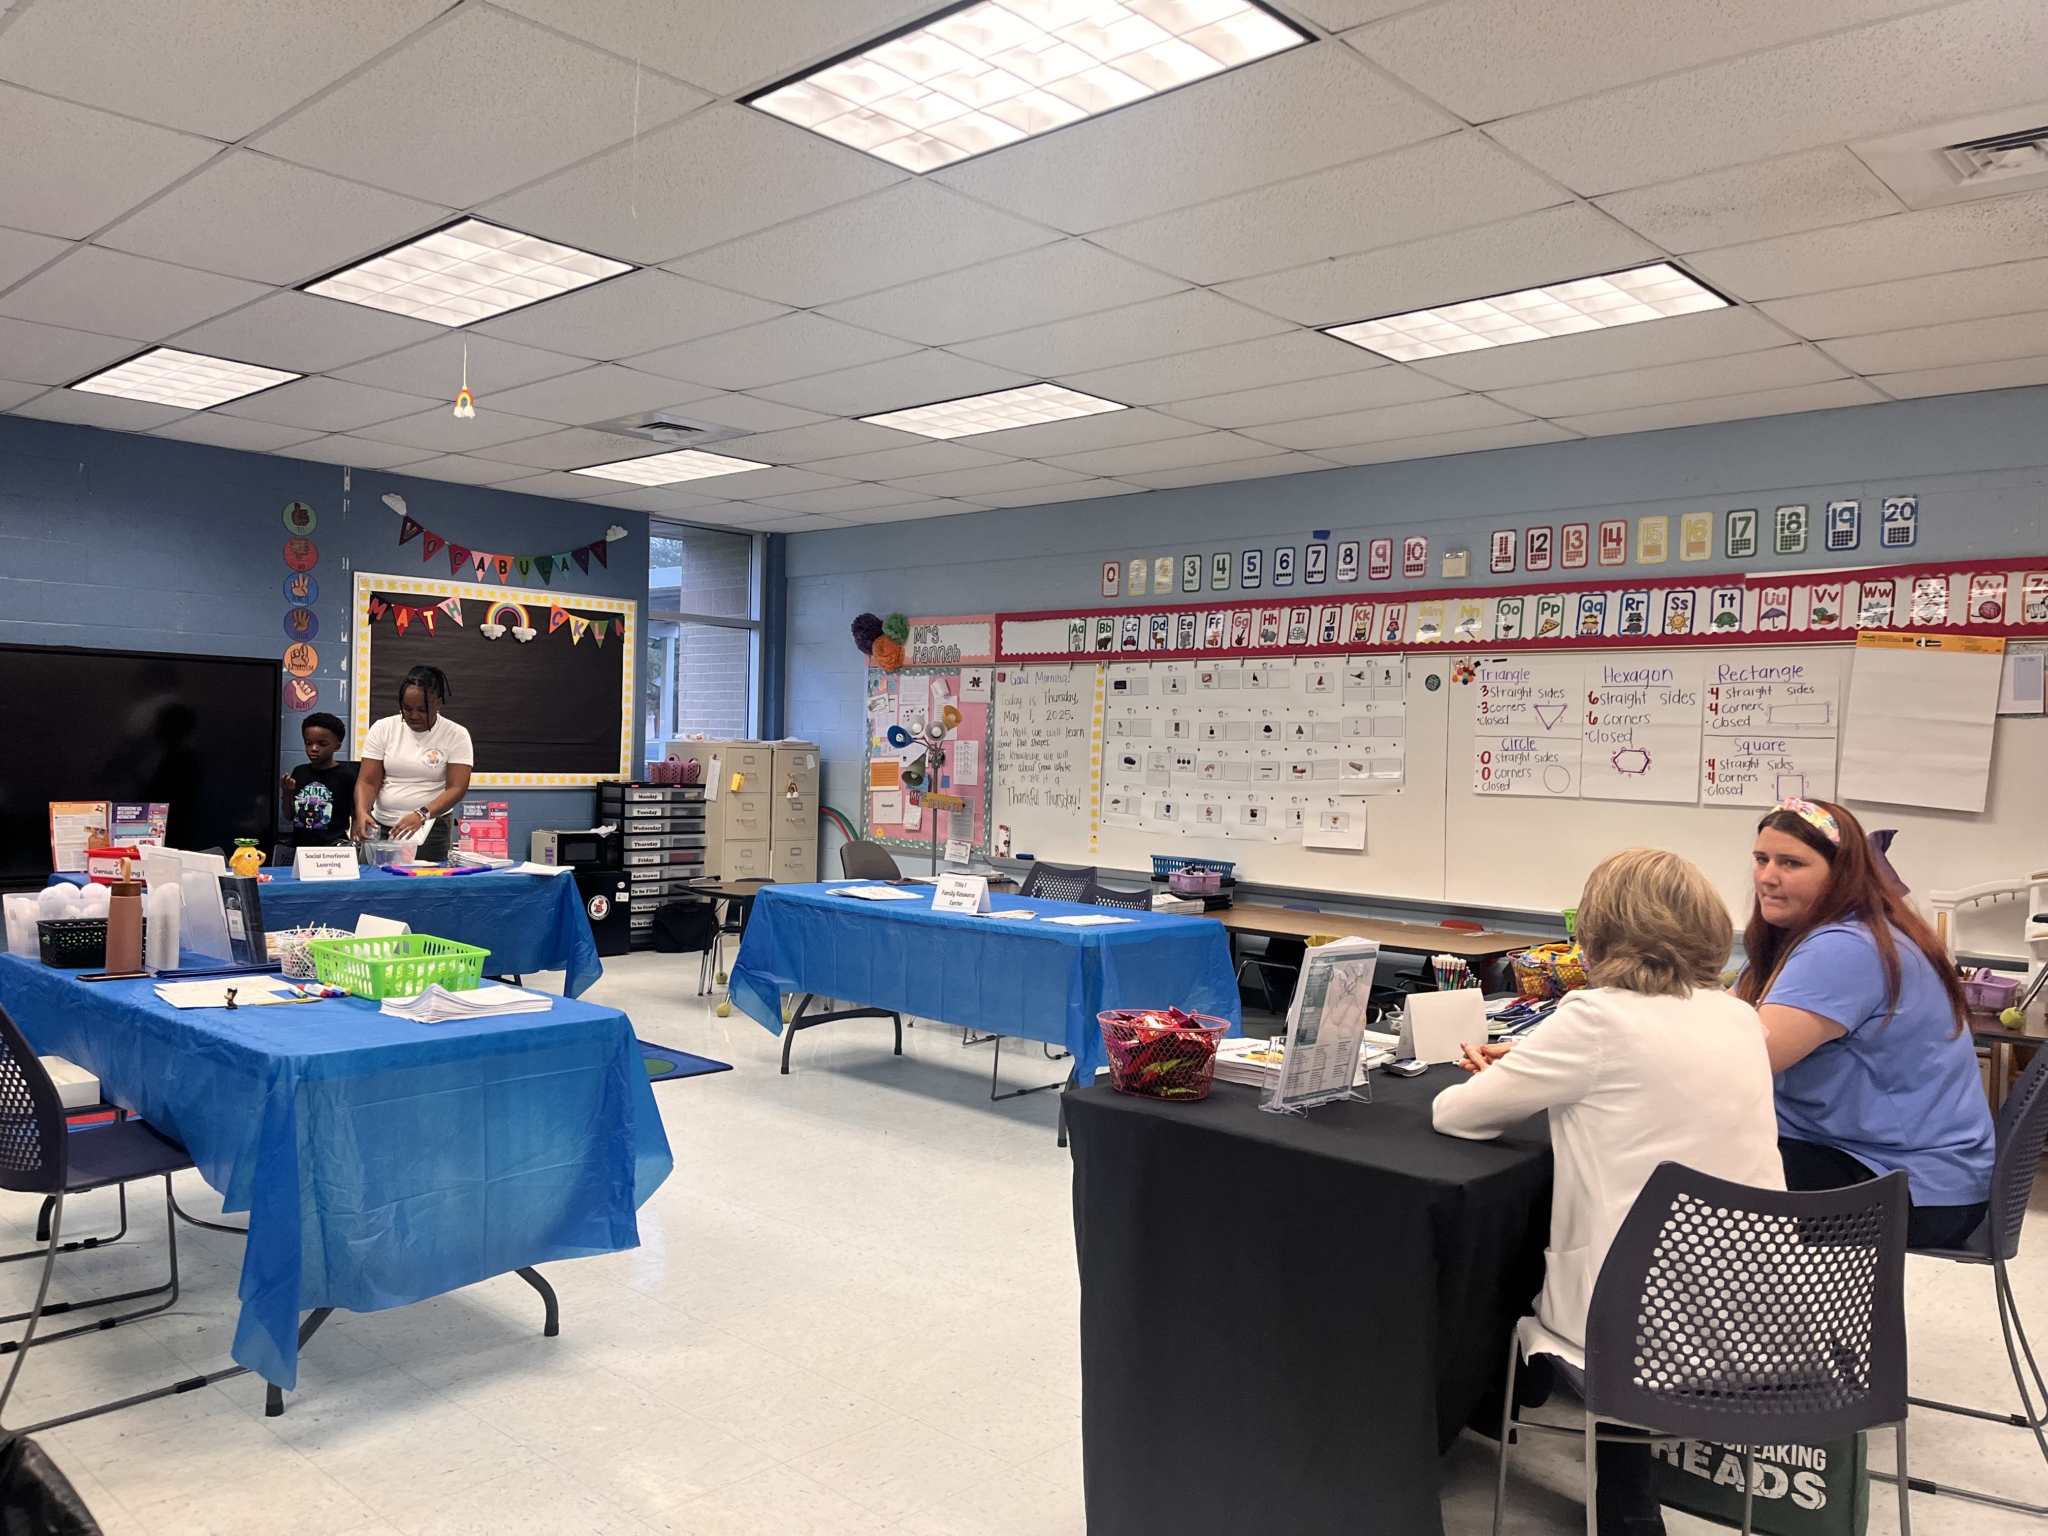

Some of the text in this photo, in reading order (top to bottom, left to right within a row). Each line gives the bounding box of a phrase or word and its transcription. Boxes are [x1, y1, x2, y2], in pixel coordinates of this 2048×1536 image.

[1831, 506, 1856, 530] 19
[1884, 502, 1915, 522] 20
[1686, 519, 1707, 541] 16
[1731, 516, 1752, 539] 17
[1780, 511, 1802, 535] 18
[1565, 529, 1583, 550] 13
[1603, 526, 1622, 548] 14
[1643, 523, 1662, 545] 15
[1499, 536, 1509, 555] 11
[1530, 533, 1548, 553] 12
[1311, 550, 1322, 568] 7
[1342, 548, 1354, 565] 8
[1375, 544, 1387, 562] 9
[1406, 542, 1424, 561] 10
[1216, 558, 1227, 575] 4
[1247, 556, 1257, 573] 5
[1279, 553, 1290, 569] 6
[1106, 566, 1116, 583] 0
[1187, 561, 1197, 577] 3
[1814, 589, 1839, 603] Vv
[1863, 585, 1892, 598] Ww
[1976, 580, 2001, 599] Yy
[1625, 598, 1644, 612] Rr
[1671, 597, 1689, 611] Ss
[1719, 593, 1736, 608] Tt
[1765, 592, 1786, 606] Uu
[367, 598, 462, 630] MATH
[1355, 609, 1370, 621] Kk
[1390, 609, 1400, 621] Ll
[1420, 606, 1442, 617] Mm
[1460, 605, 1480, 617] Nn
[1500, 603, 1520, 615] Oo
[1541, 602, 1560, 617] Pp
[1582, 600, 1603, 615] Qq
[552, 611, 626, 640] CKLA
[1152, 620, 1166, 631] Dd
[1180, 619, 1193, 630] Ee
[1209, 617, 1220, 628] Ff
[1234, 616, 1249, 629] Gg
[1263, 613, 1277, 626] Hh
[1295, 612, 1305, 624] Ii
[1326, 611, 1336, 625] Jj
[913, 626, 943, 644] Mrs.
[1071, 623, 1084, 634] Aa
[1099, 623, 1111, 633] Bb
[1125, 623, 1137, 632] Cc
[913, 644, 961, 664] Hannah
[1010, 670, 1071, 687] Good Morning!
[1480, 668, 1531, 685] Triangle
[1604, 665, 1673, 689] Hexagon
[1718, 664, 1803, 684] Rectangle
[1481, 685, 1489, 697] 3
[1588, 691, 1599, 705] 6
[1711, 685, 1815, 700] 4 straight sides
[1001, 693, 1022, 710] Today
[1029, 697, 1037, 706] is
[1481, 701, 1489, 714] 3
[1709, 703, 1718, 715] 4
[1004, 710, 1019, 724] May
[1046, 709, 1074, 721] 2025.
[1588, 711, 1598, 725] 6
[1000, 727, 1008, 737] In
[1032, 728, 1042, 737] we
[1046, 727, 1061, 737] will
[1065, 726, 1085, 738] learn
[996, 739, 1012, 749] about
[1501, 737, 1537, 751] Circle
[1734, 738, 1786, 755] Square
[997, 751, 1005, 760] In
[1057, 750, 1068, 760] will
[1480, 751, 1491, 764] 0
[1534, 752, 1559, 763] sides
[998, 762, 1013, 772] learn
[1708, 758, 1715, 770] 4
[1720, 757, 1759, 771] straight
[1481, 767, 1491, 780] 0
[1708, 772, 1715, 784] 4
[1007, 786, 1081, 816] Thankful Thursday!
[93, 867, 113, 875] Genius
